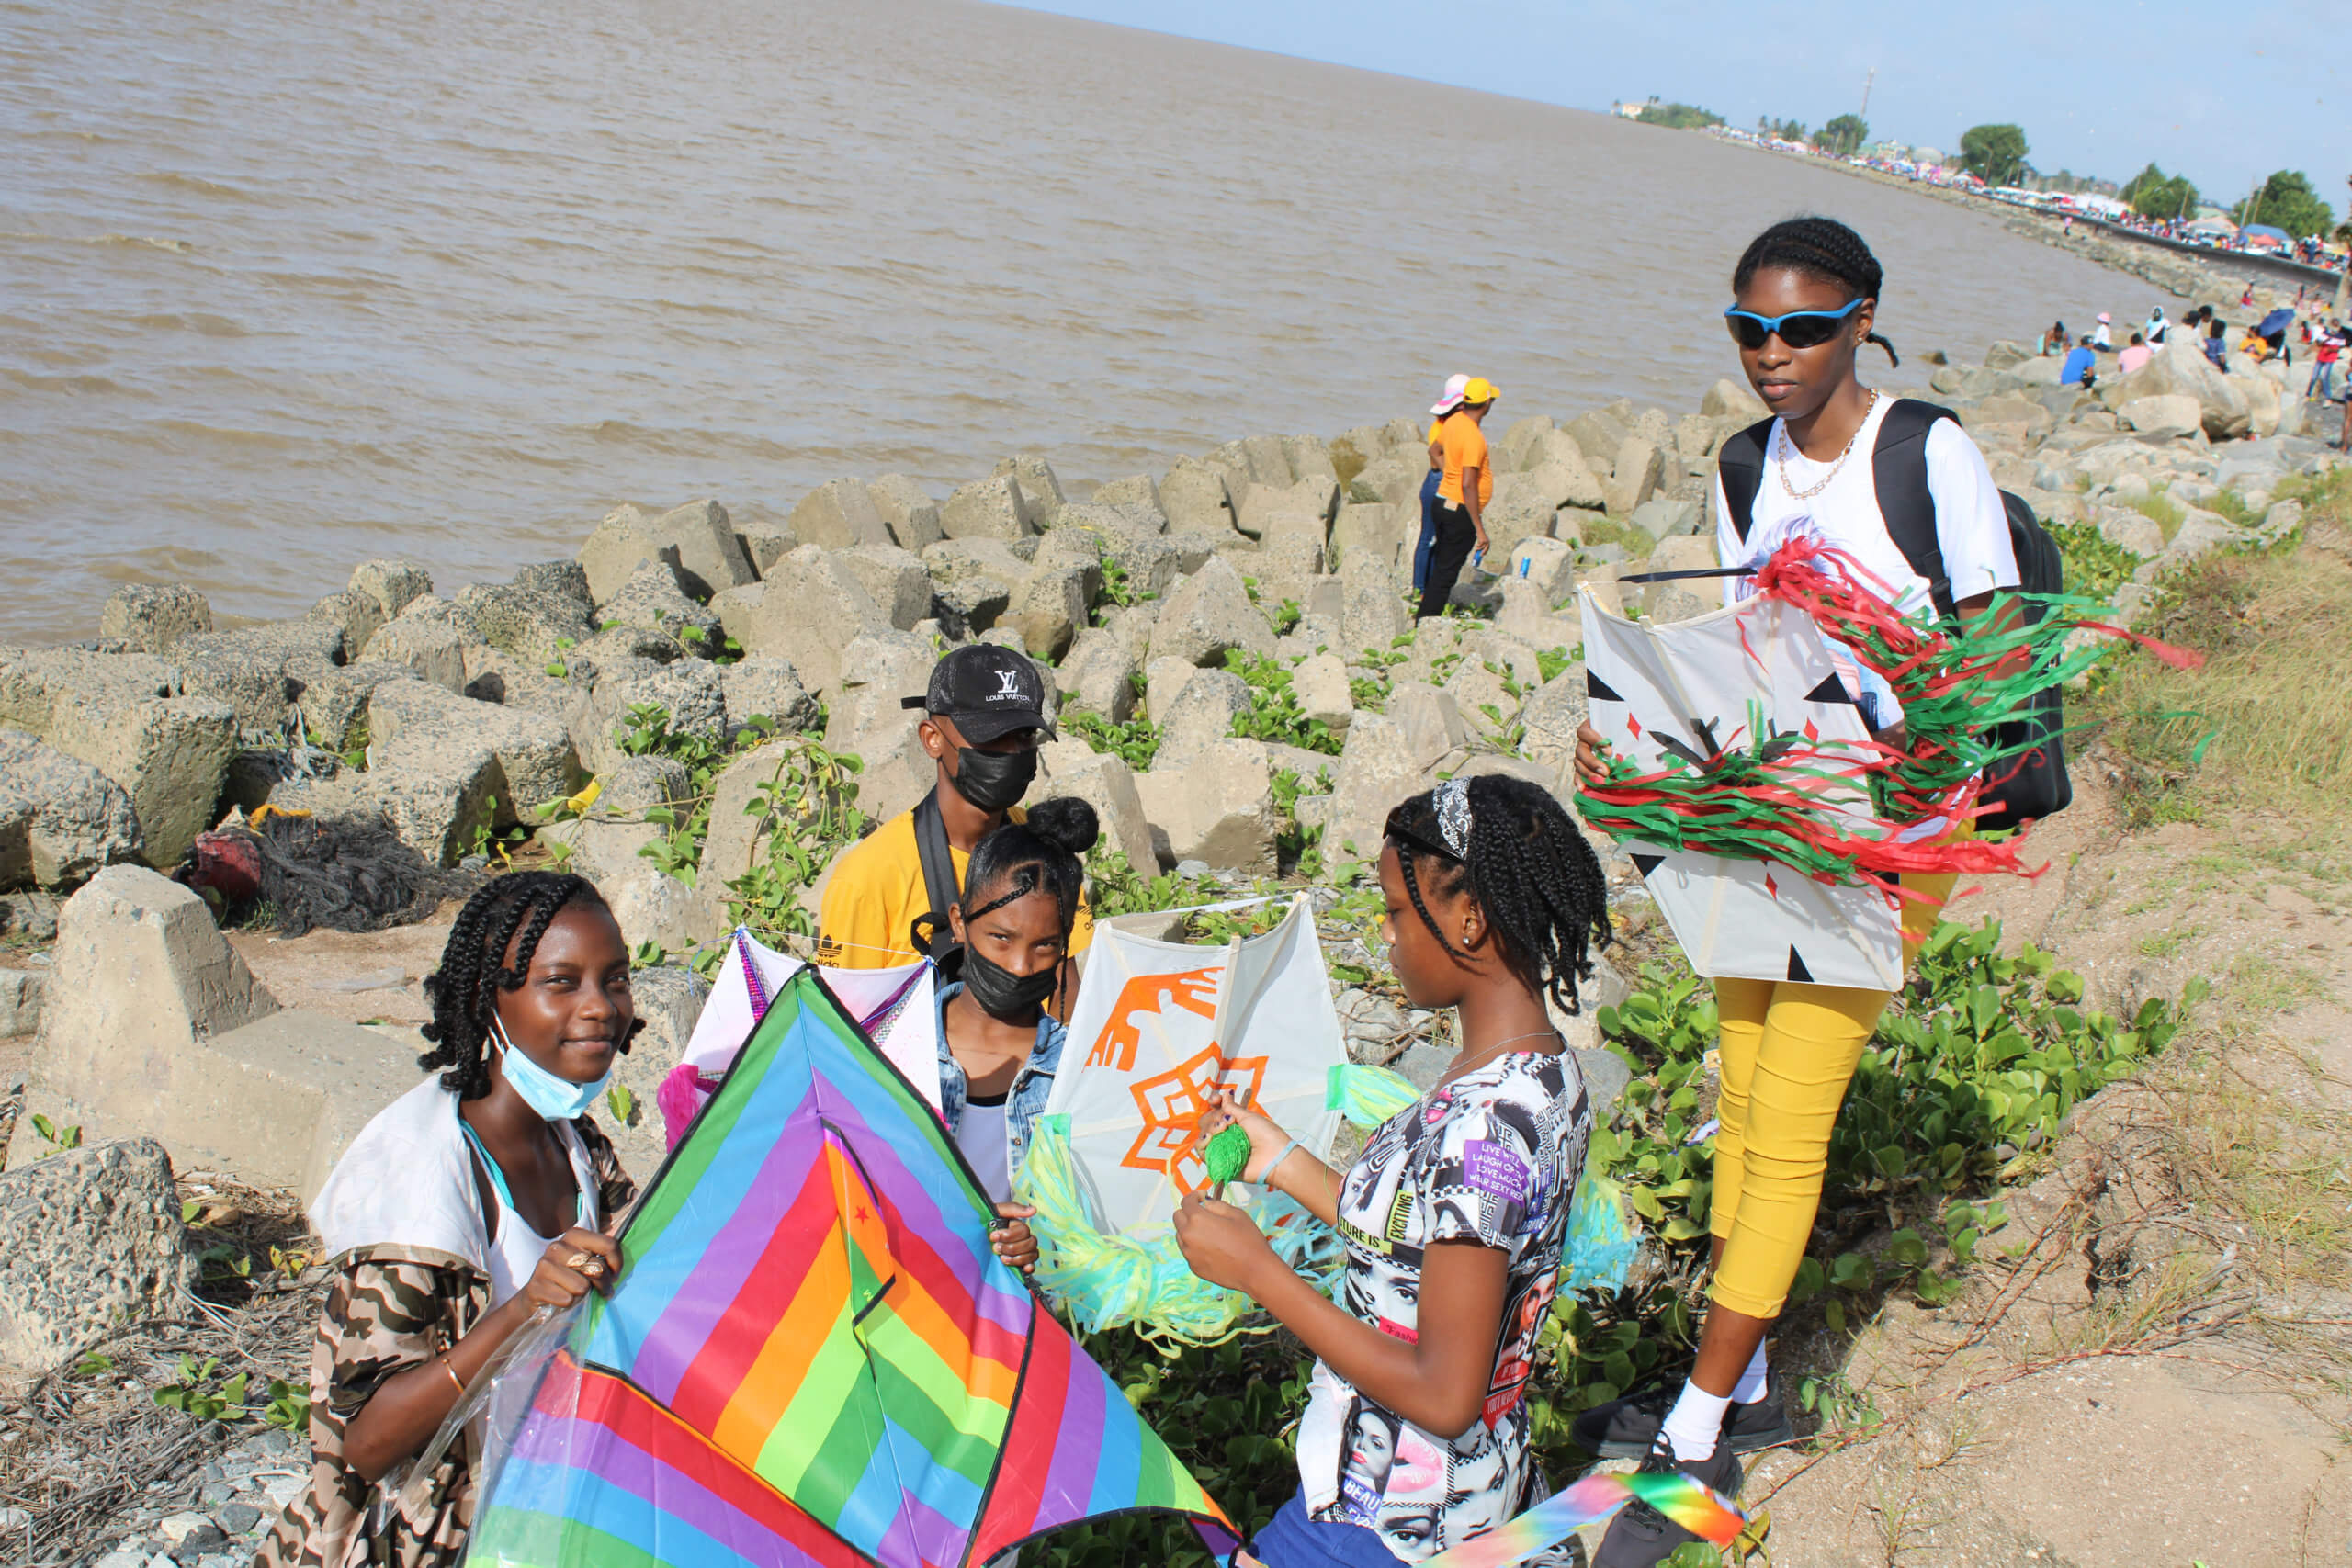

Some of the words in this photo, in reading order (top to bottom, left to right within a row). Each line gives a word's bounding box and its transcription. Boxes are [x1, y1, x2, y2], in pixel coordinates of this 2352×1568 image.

[985, 694, 1005, 702] LOUIS
[1005, 694, 1030, 702] VUITTON
[1482, 1143, 1501, 1156] LIVE
[1472, 1153, 1503, 1168] LAUGH
[1477, 1164, 1498, 1179] LOVE
[1499, 1174, 1522, 1190] MUCH
[1490, 1180, 1510, 1194] SEXY
[1390, 1193, 1414, 1240] EXCITING
[1368, 1234, 1380, 1248] IS
